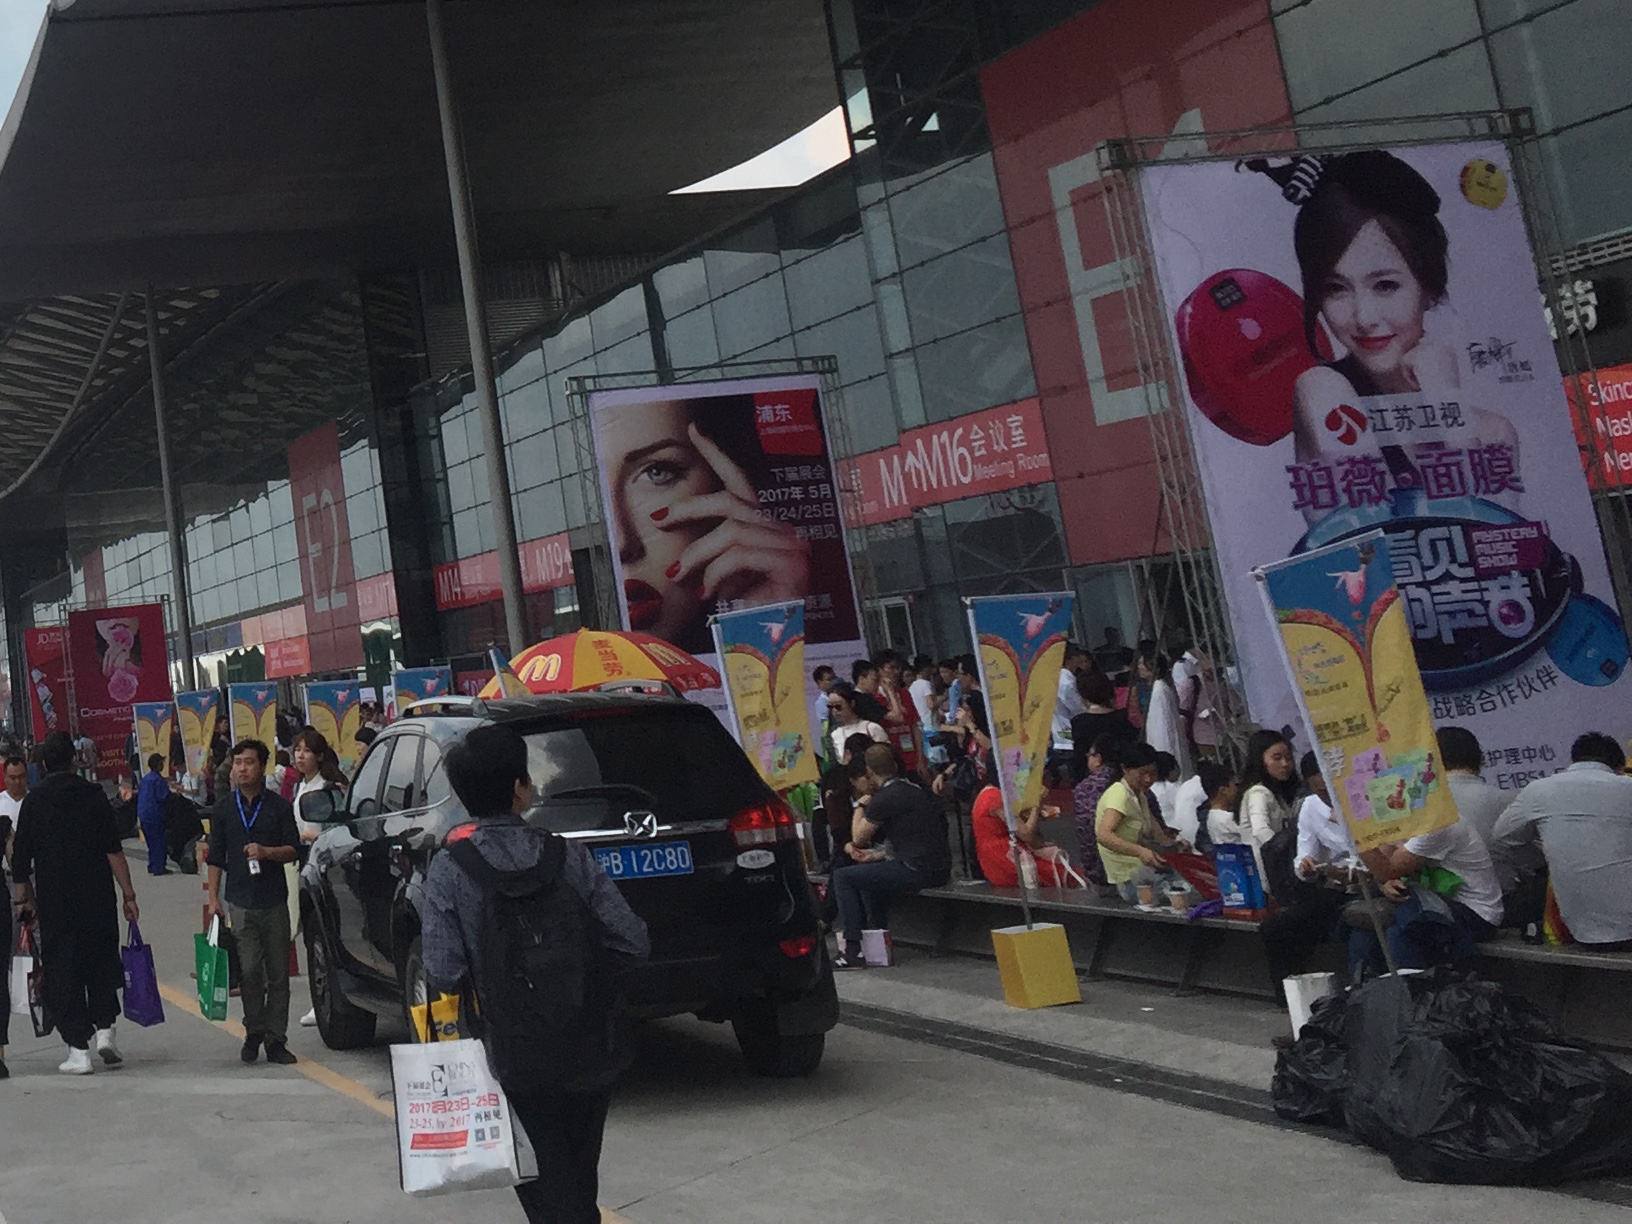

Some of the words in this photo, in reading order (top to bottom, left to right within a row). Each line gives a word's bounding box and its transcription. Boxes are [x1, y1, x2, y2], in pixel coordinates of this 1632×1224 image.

[756, 404, 793, 423] 浦东
[1369, 401, 1466, 433] 江苏卫视
[969, 414, 1028, 457] 会议室
[1016, 452, 1050, 471] Room
[770, 464, 828, 483] 下届展会
[1472, 526, 1538, 543] MYSTERY
[302, 487, 348, 614] E2
[1474, 541, 1519, 556] MUSIC
[1477, 554, 1519, 568] SHOW
[1433, 664, 1559, 720] 战略合作伙伴
[1483, 743, 1557, 767] 护理中心
